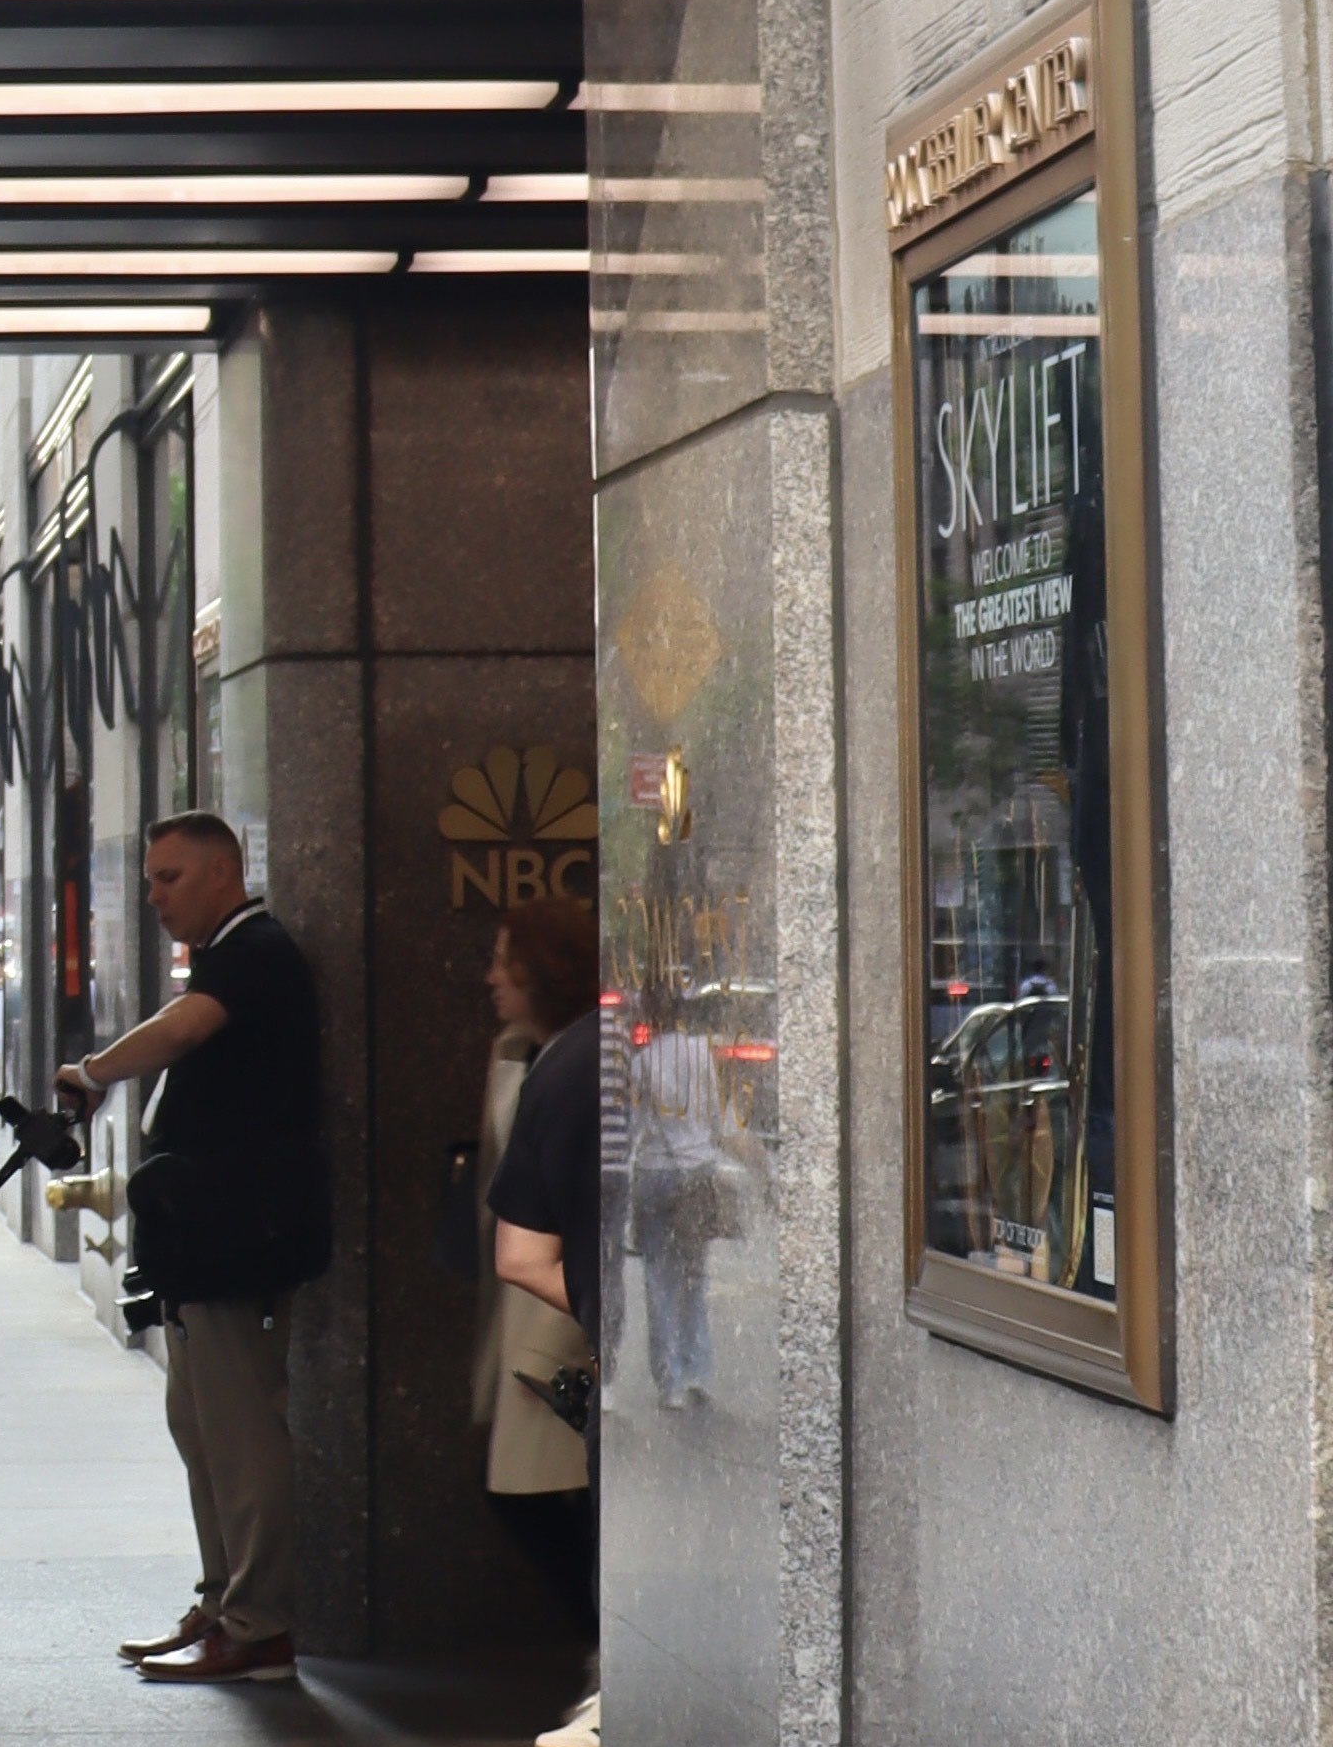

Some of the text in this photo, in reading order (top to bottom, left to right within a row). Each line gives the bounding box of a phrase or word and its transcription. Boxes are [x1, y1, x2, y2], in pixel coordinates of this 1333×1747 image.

[938, 342, 1086, 538] SKYLIFT
[972, 531, 1052, 587] WELCOME TO
[954, 574, 1073, 639] THE GREATEST VIEW
[971, 630, 1056, 682] IN THE WORLD
[452, 847, 594, 910] NBC
